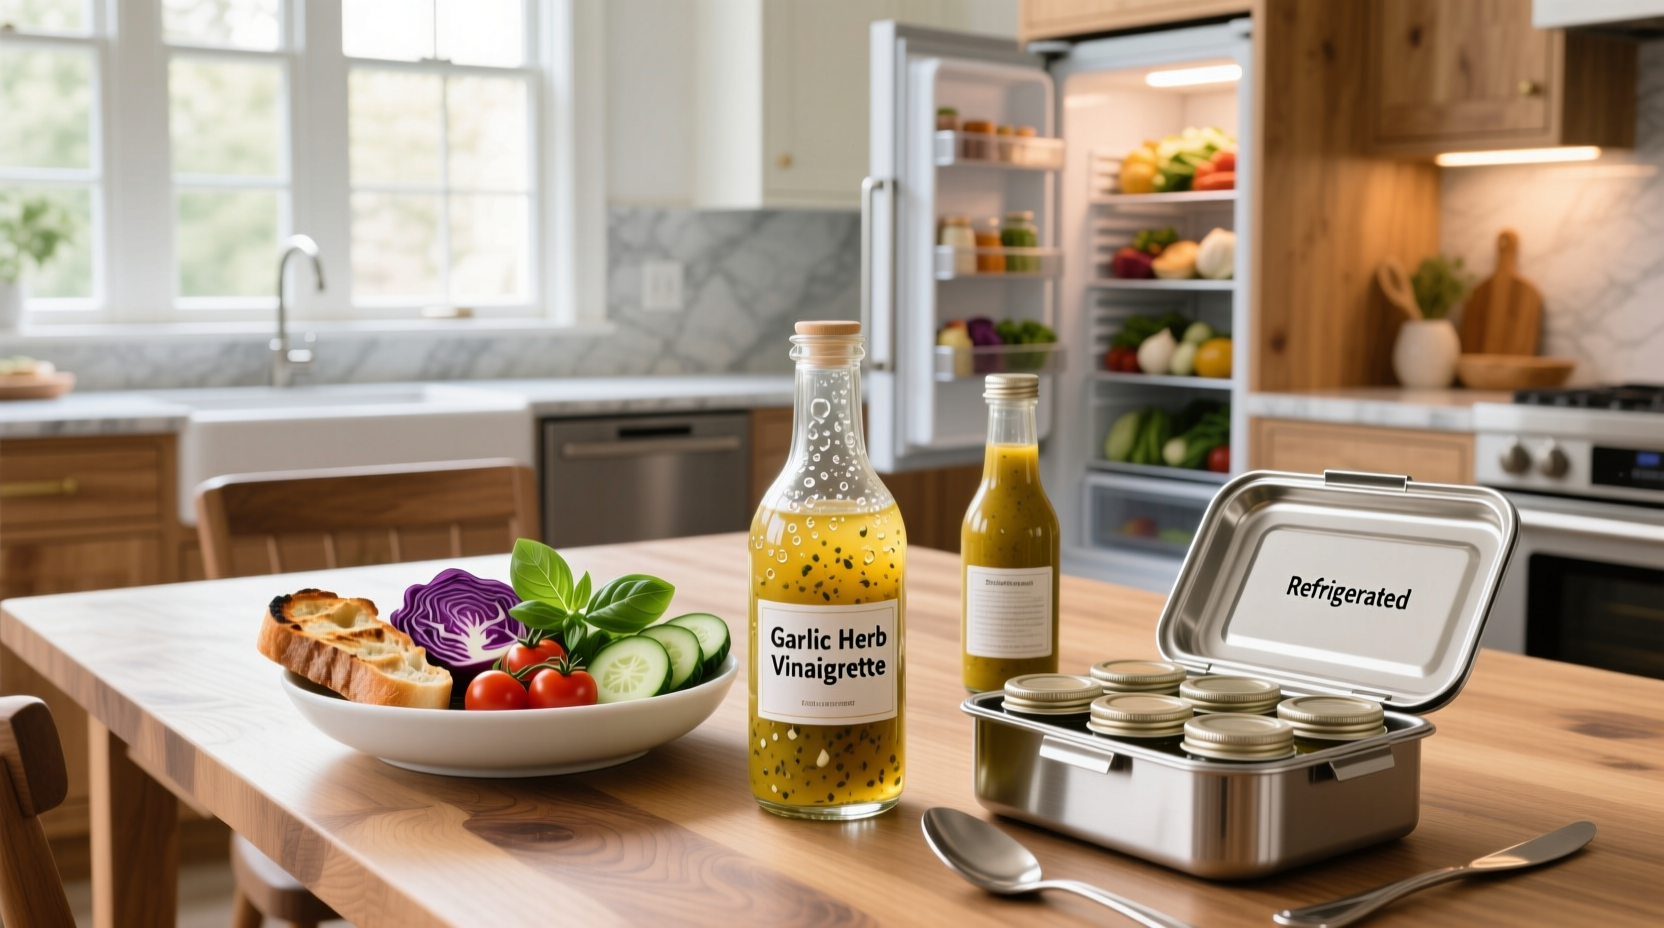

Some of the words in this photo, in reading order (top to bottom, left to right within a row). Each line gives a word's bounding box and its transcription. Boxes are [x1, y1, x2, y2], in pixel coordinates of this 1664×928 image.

[1286, 575, 1412, 610] Refrigerated
[771, 626, 831, 650] Garlic
[839, 625, 887, 649] Herb
[771, 654, 886, 686] Vinaigrette
